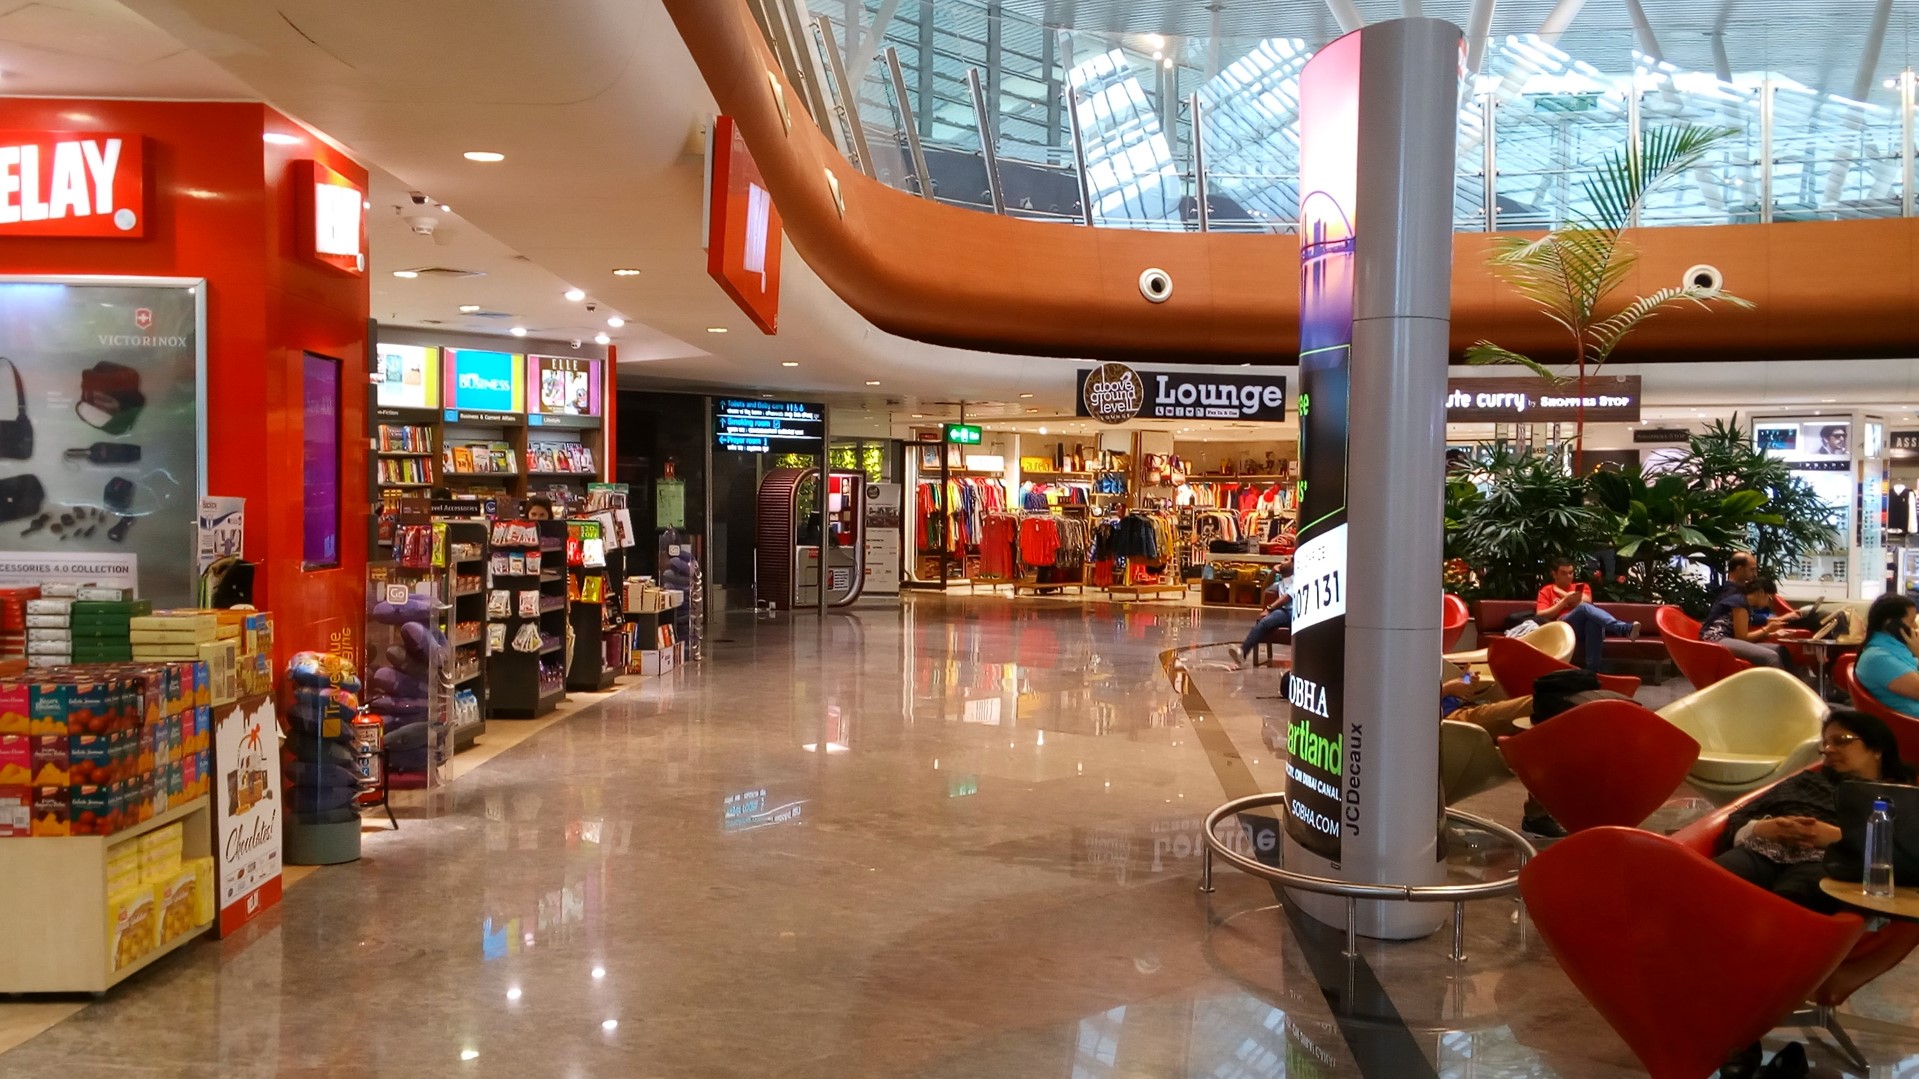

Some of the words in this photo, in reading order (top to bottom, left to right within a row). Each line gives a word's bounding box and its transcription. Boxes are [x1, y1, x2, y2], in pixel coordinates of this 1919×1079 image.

[0, 138, 122, 224] ELAY
[98, 334, 187, 347] VICTORINOX
[551, 358, 578, 371] ELLE
[1155, 375, 1283, 414] Lounge
[1476, 392, 1525, 412] curry
[727, 417, 754, 428] Smoking
[1896, 437, 1919, 448] ASS
[0, 564, 51, 573] CESSORIES
[53, 565, 69, 573] 4.0
[71, 565, 129, 573] COLLECTION
[1288, 672, 1329, 718] OBHA
[1286, 719, 1343, 777] artland
[1345, 722, 1363, 836] JCDecaux
